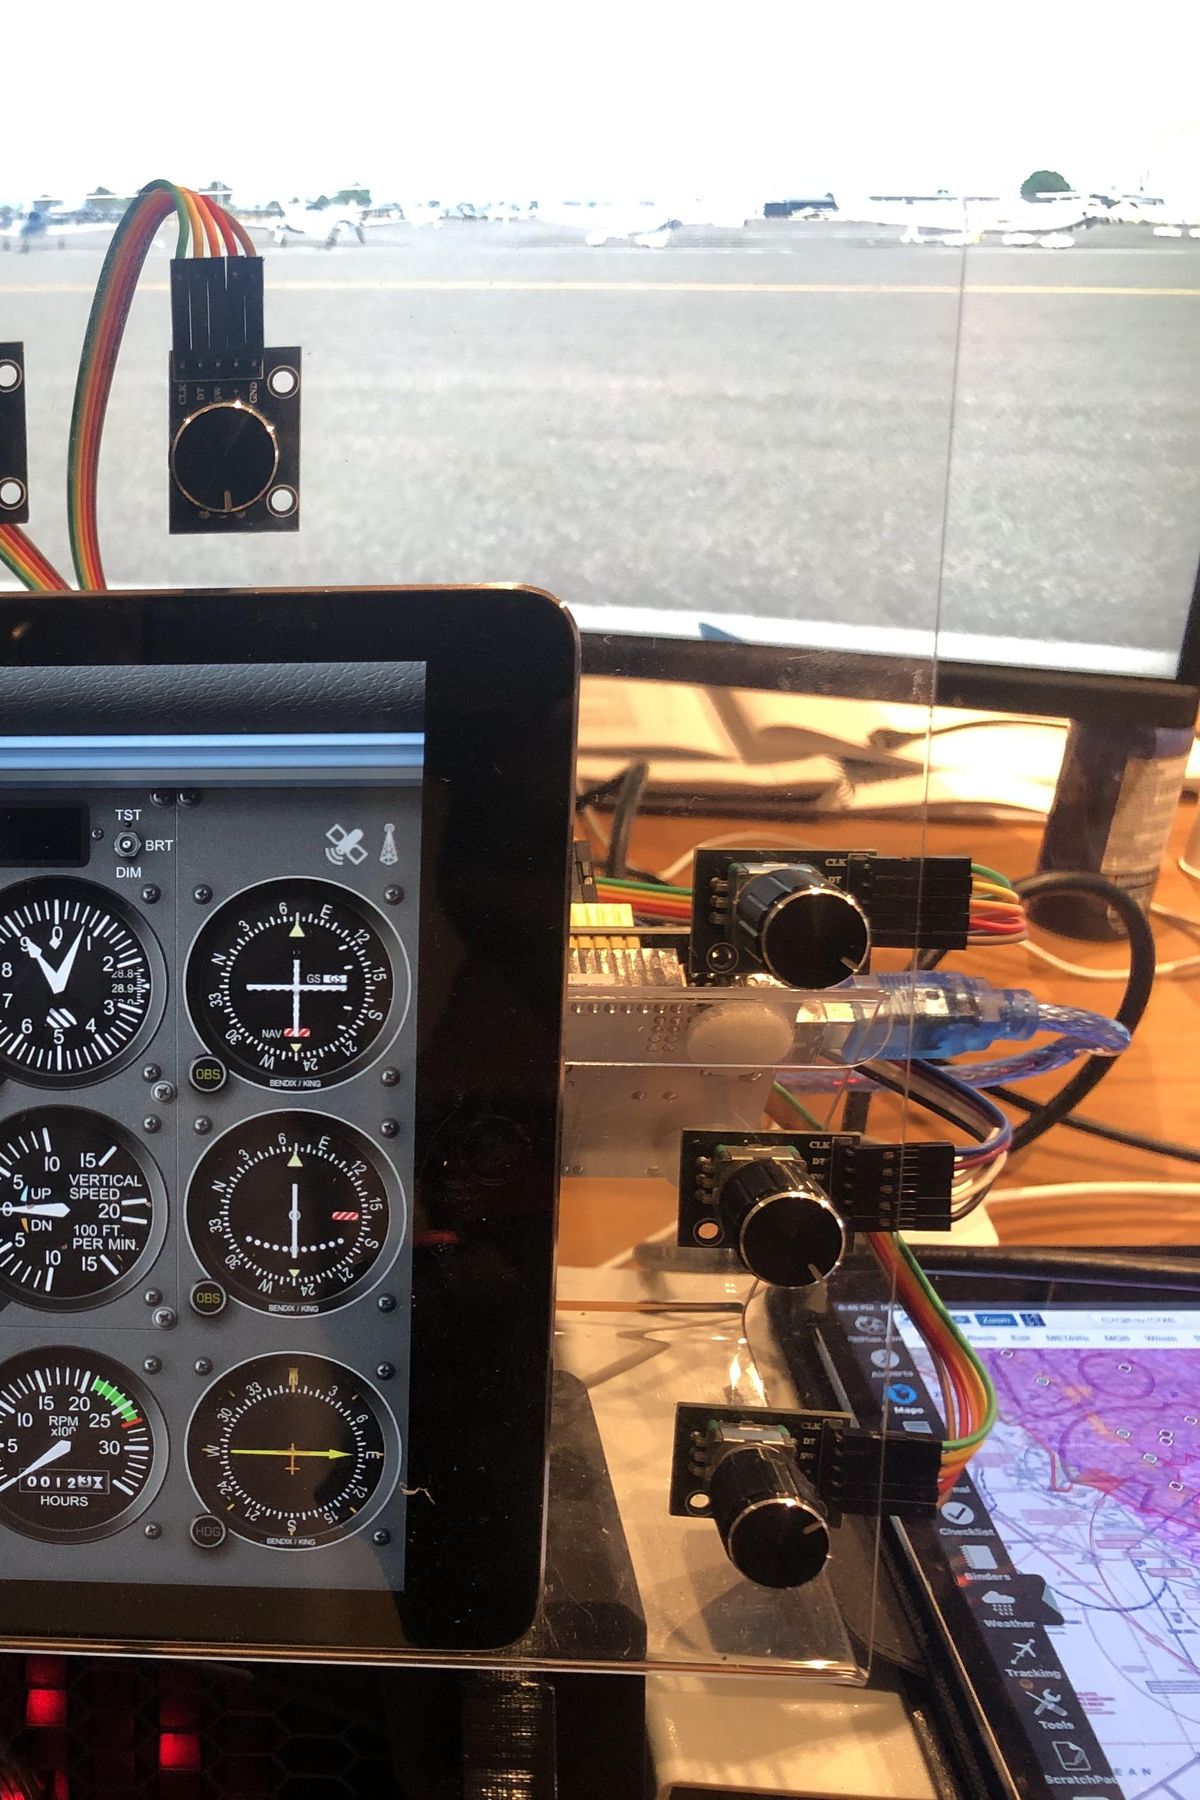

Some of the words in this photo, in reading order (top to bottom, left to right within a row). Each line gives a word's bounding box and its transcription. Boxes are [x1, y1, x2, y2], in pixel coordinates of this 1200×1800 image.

[115, 810, 142, 821] TST
[146, 840, 173, 851] BRT
[116, 867, 142, 878] DIM
[307, 974, 320, 983] GS
[112, 984, 133, 993] 28.9
[262, 1029, 282, 1038] NAV
[809, 1141, 830, 1149] CLK
[44, 1157, 60, 1171] 10
[80, 1153, 96, 1168] 15
[13, 1175, 23, 1189] 5
[69, 1174, 142, 1186] VERTICAL
[31, 1188, 51, 1199] UP
[70, 1188, 120, 1200] SPEED
[98, 1204, 120, 1219] 20
[31, 1220, 52, 1231] DN
[73, 1225, 97, 1237] 100
[102, 1225, 125, 1237] FT.
[15, 1233, 25, 1247] 5
[73, 1238, 102, 1249] PER
[108, 1238, 139, 1251] MIN.
[46, 1250, 60, 1265] 10
[82, 1256, 97, 1271] 15
[197, 1293, 220, 1303] OBS
[39, 1396, 54, 1410] 15
[69, 1397, 90, 1411] 20
[18, 1413, 33, 1427] 10
[49, 1416, 78, 1426] RPM
[89, 1414, 110, 1428] 25
[8, 1439, 18, 1452] 5
[99, 1441, 120, 1454] 30
[40, 1496, 88, 1506] HOURS
[196, 1527, 221, 1536] HDG
[939, 1528, 995, 1537] Checklist
[964, 1573, 1011, 1581] Binders
[983, 1620, 1035, 1629] Weather
[1005, 1669, 1062, 1679] Tracking
[1039, 1720, 1075, 1730] Tools
